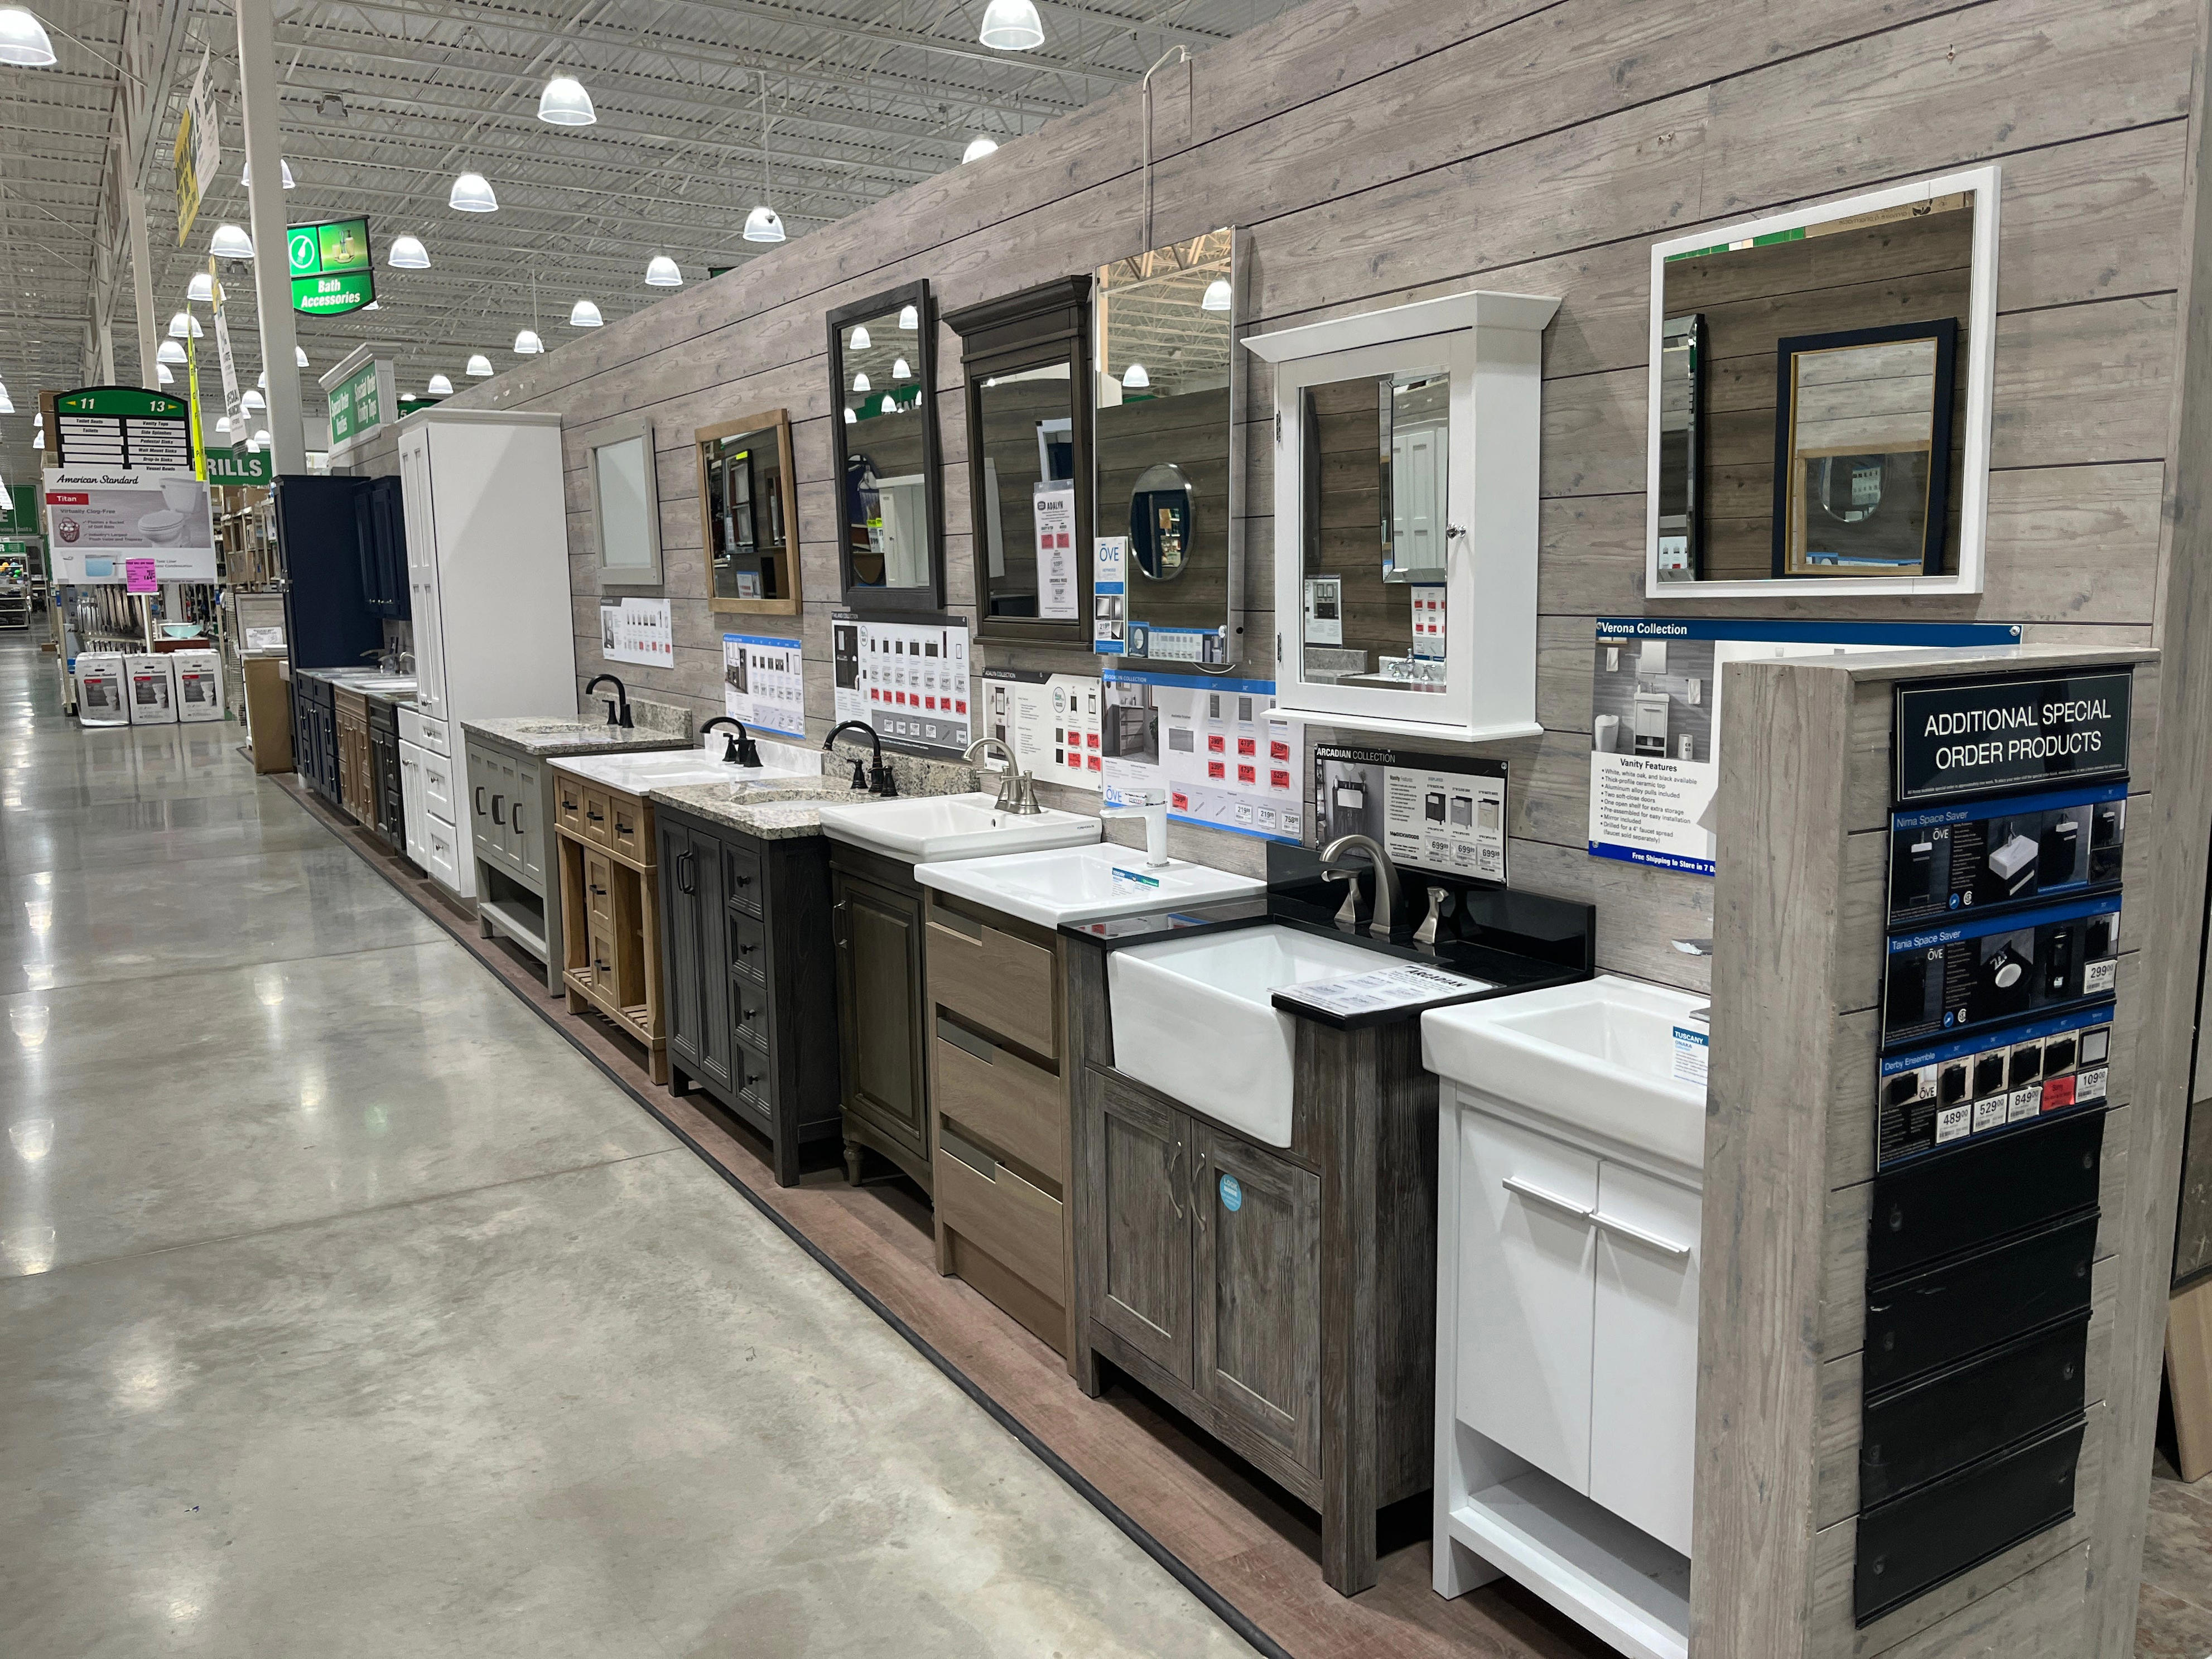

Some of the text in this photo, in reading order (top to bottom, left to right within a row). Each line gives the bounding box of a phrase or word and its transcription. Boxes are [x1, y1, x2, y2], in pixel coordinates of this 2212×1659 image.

[318, 279, 341, 293] Bath
[301, 291, 360, 308] Accessories
[80, 398, 95, 409] 11
[150, 401, 165, 412] 13
[56, 474, 139, 484] American Standard
[1602, 621, 1687, 635] Verona Collection
[1924, 698, 2112, 737] ADDITIONAL SPECIAL
[1317, 747, 1395, 763] ARCADIAN COLLECTION
[1935, 730, 2102, 769] ORDER PRODUCTS
[1620, 758, 1677, 772] Vanity Features
[1604, 776, 1635, 785] Thick-profile
[1604, 783, 1630, 792] Aluminum
[1673, 777, 1697, 785] available
[1616, 793, 1640, 801] soft-close
[1604, 807, 1640, 816] Pre-assembled
[1662, 815, 1691, 824] installation
[1897, 812, 1968, 827] Nima Space Saver
[1633, 834, 1660, 843] separately)
[1632, 852, 1645, 860] Free
[1645, 854, 1671, 866] Shipping
[1679, 860, 1695, 869] Store
[1892, 931, 1961, 950] Tania Space Saver
[1406, 969, 1467, 987] ARCADIAN
[1675, 1031, 1704, 1044] TUSCANY
[1675, 1040, 1692, 1049] ONAKA
[1885, 1052, 1935, 1071] Derby Ensemble
